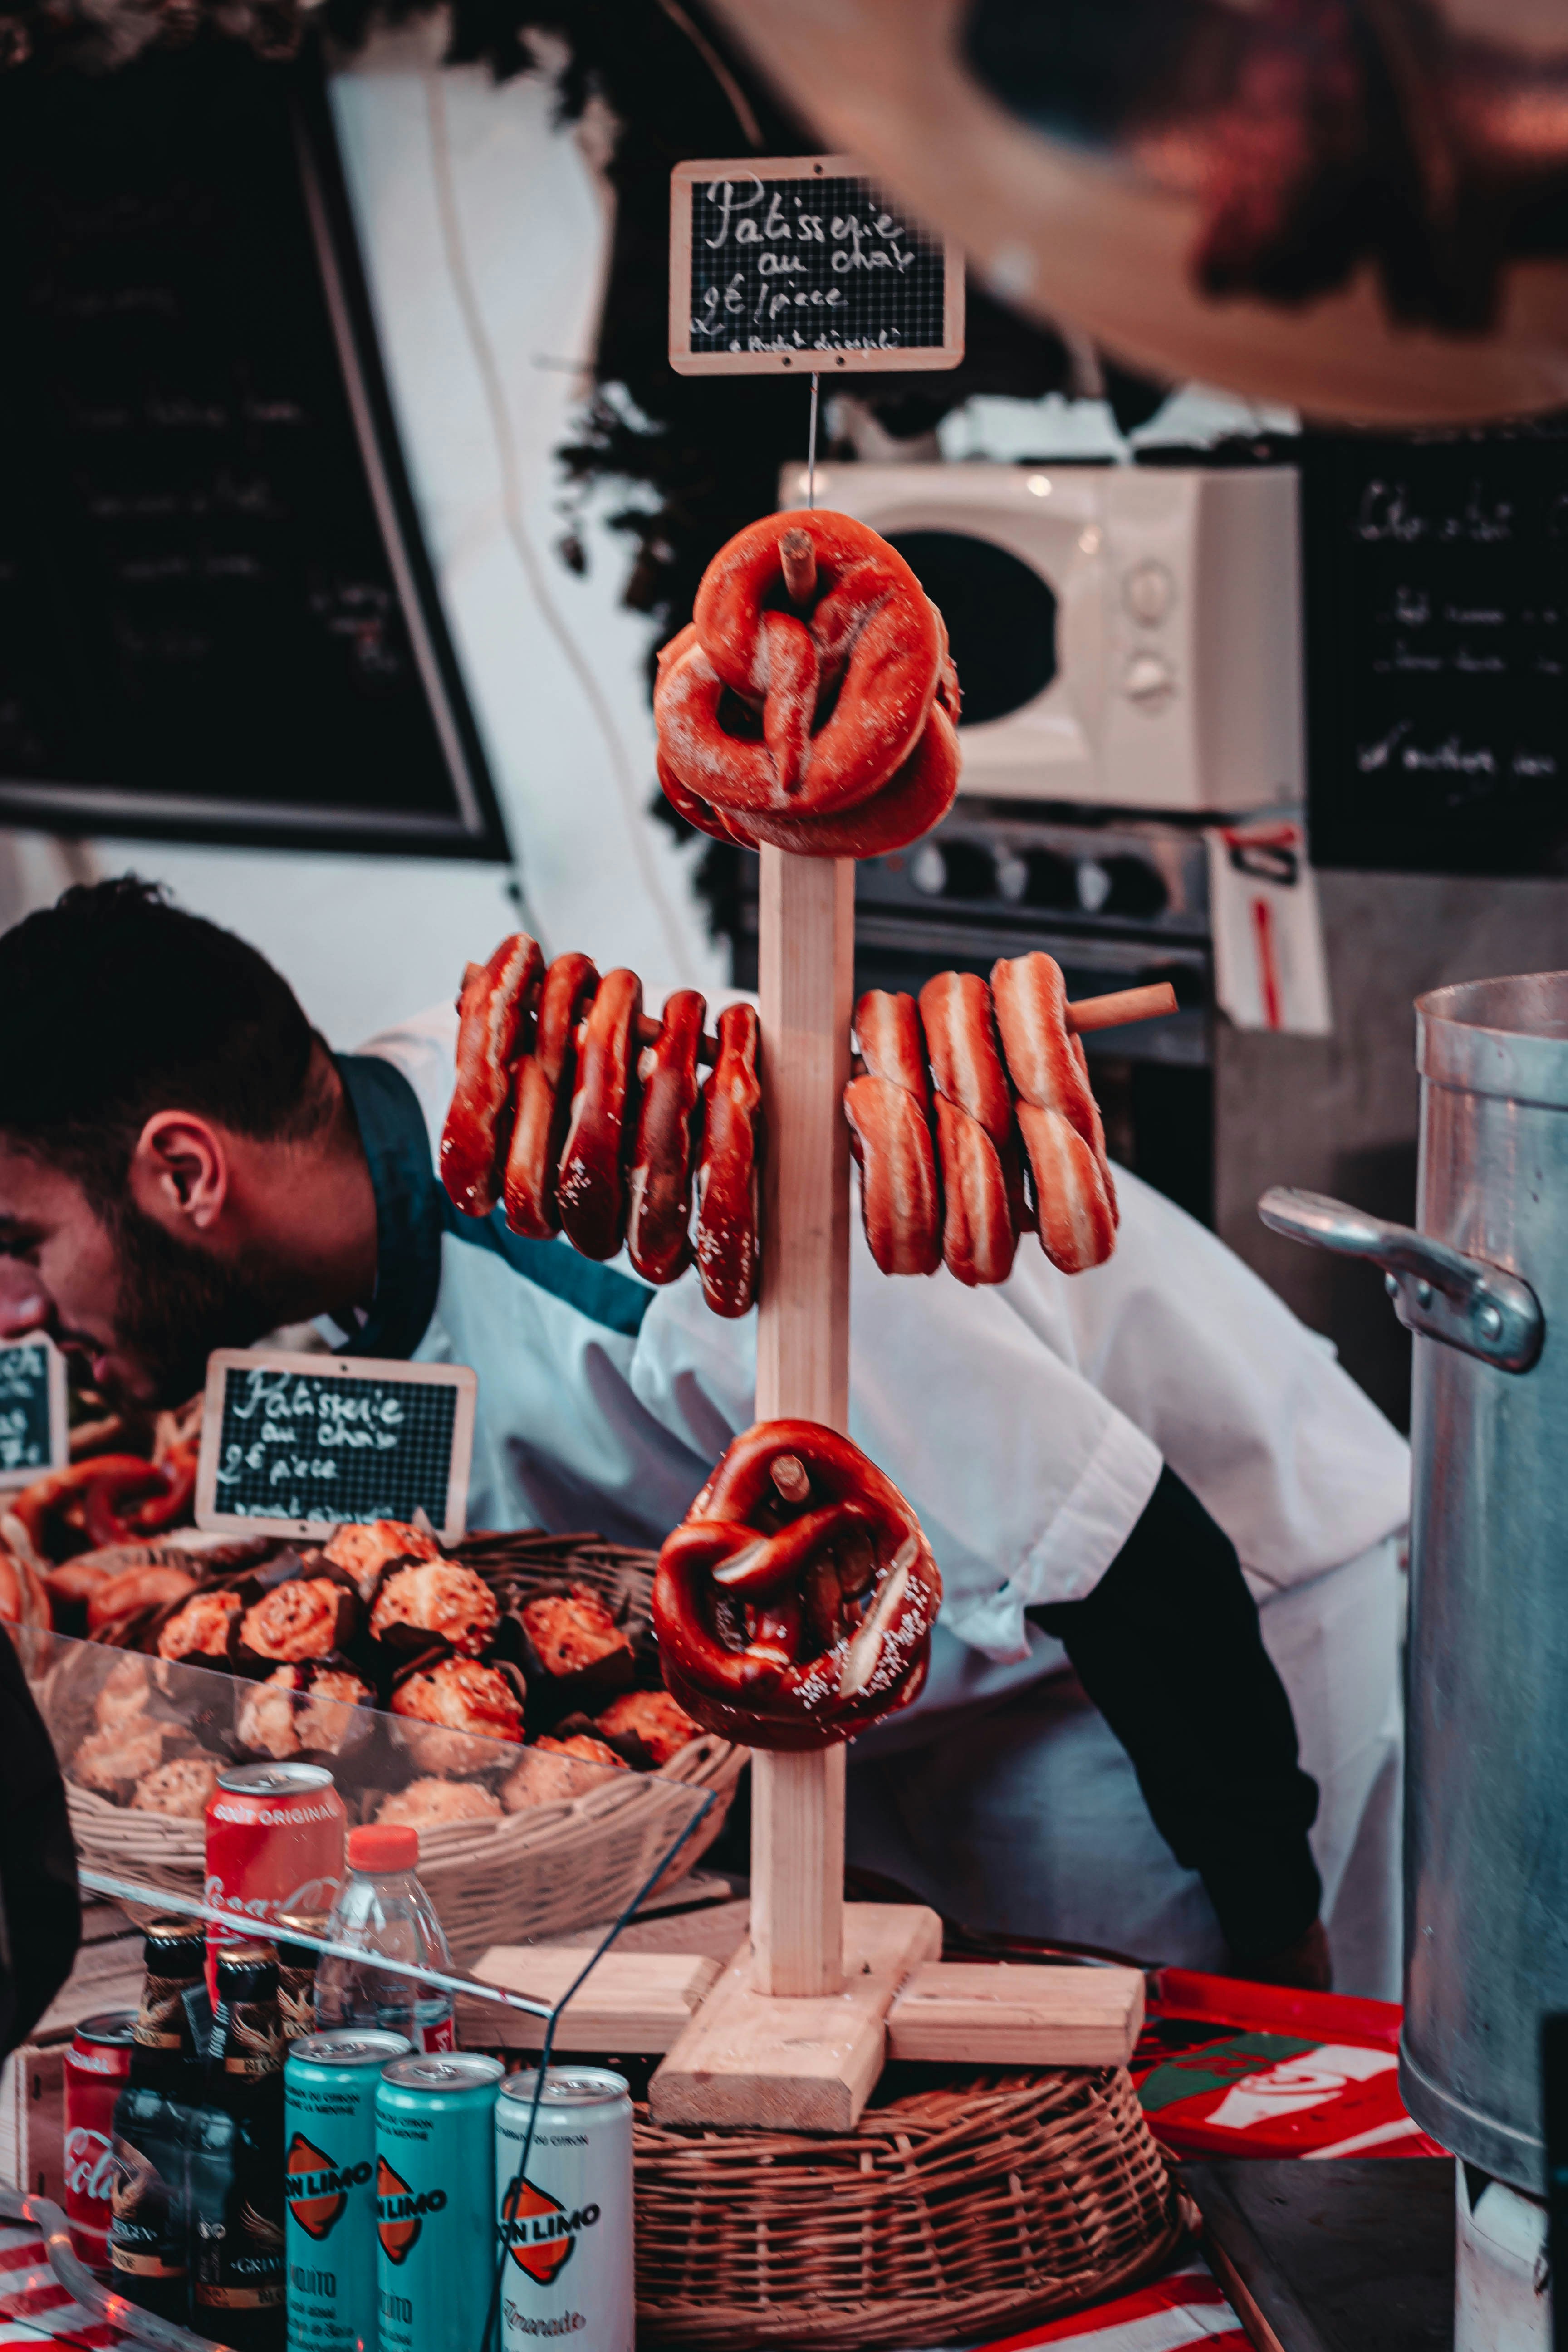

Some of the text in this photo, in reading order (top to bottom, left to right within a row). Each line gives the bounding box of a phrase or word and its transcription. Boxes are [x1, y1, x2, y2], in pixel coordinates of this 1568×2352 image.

[757, 252, 808, 276] au
[261, 1421, 296, 1443] au
[258, 1803, 338, 1826] ORIGINAL
[307, 2161, 373, 2195] LIMO
[387, 2189, 448, 2219] LIMO
[533, 2202, 601, 2239] LIMO
